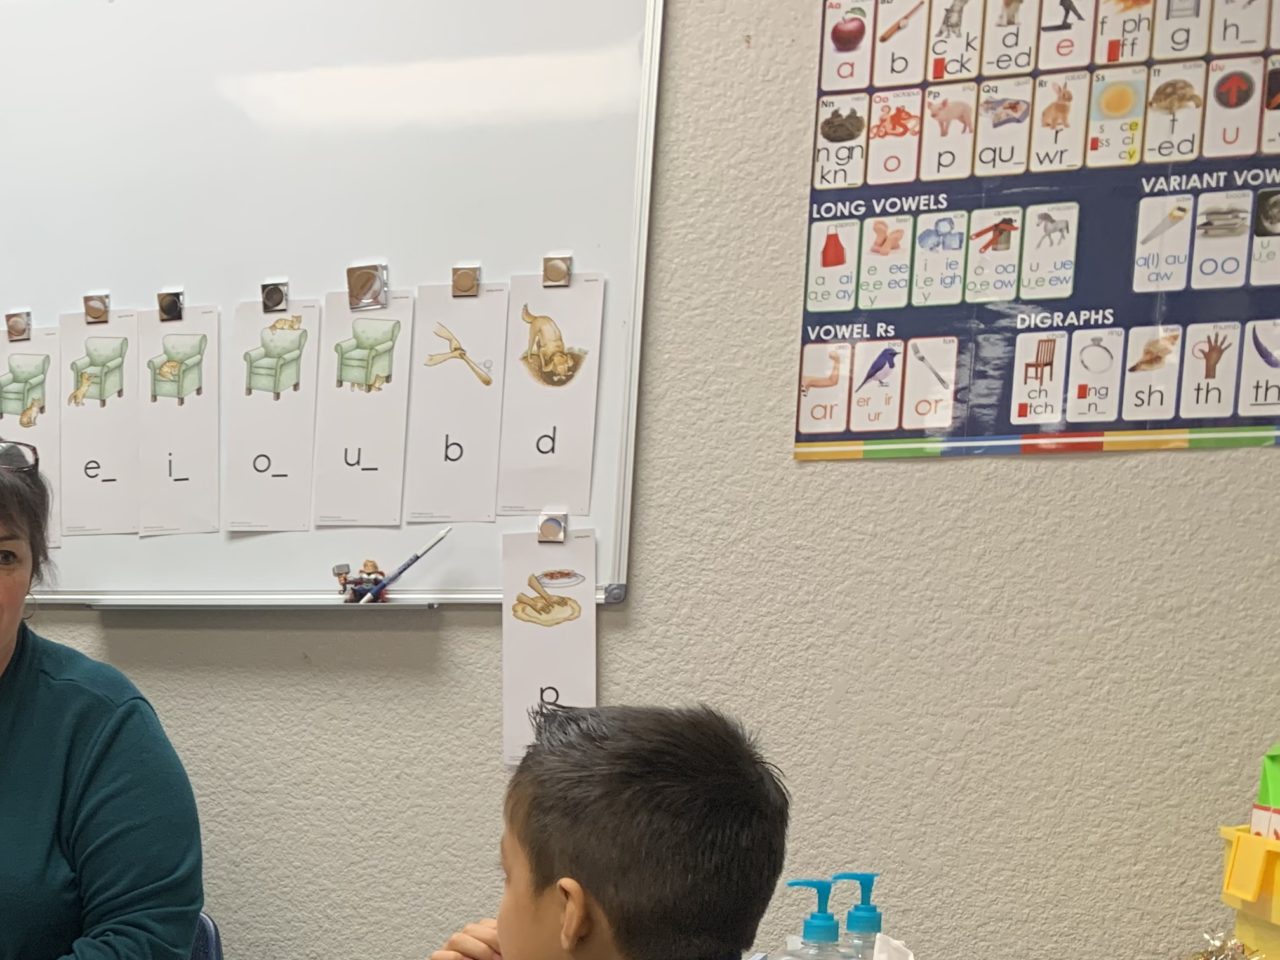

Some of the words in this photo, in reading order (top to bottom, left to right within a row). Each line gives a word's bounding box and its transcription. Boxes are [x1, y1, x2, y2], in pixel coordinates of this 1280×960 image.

[1122, 14, 1151, 37] ph
[966, 31, 978, 52] k
[1002, 26, 1020, 49] d
[1056, 38, 1074, 57] e
[1171, 27, 1190, 52] g
[837, 62, 855, 79] a
[890, 52, 908, 74] b
[944, 53, 972, 75] ck
[937, 150, 956, 174] p
[1141, 171, 1228, 193] VARIANT
[812, 200, 867, 218] LONG
[872, 193, 948, 214] VOWELS
[889, 263, 909, 275] ee
[1199, 256, 1240, 276] oo
[888, 278, 908, 289] ea
[940, 272, 962, 289] igh
[993, 278, 1016, 290] ow
[1048, 275, 1071, 287] ew
[1147, 271, 1174, 282] aw
[1016, 308, 1115, 330] DIGRAPHS
[807, 323, 870, 341] VOWEL
[876, 322, 896, 338] Rs
[856, 396, 872, 408] er
[1027, 386, 1048, 401] ch
[1088, 385, 1109, 400] ng
[1134, 384, 1165, 407] sh
[1194, 381, 1222, 404] th
[810, 402, 839, 421] ar
[867, 410, 882, 423] ur
[914, 397, 944, 417] or
[444, 434, 464, 463] b
[535, 426, 557, 454] d
